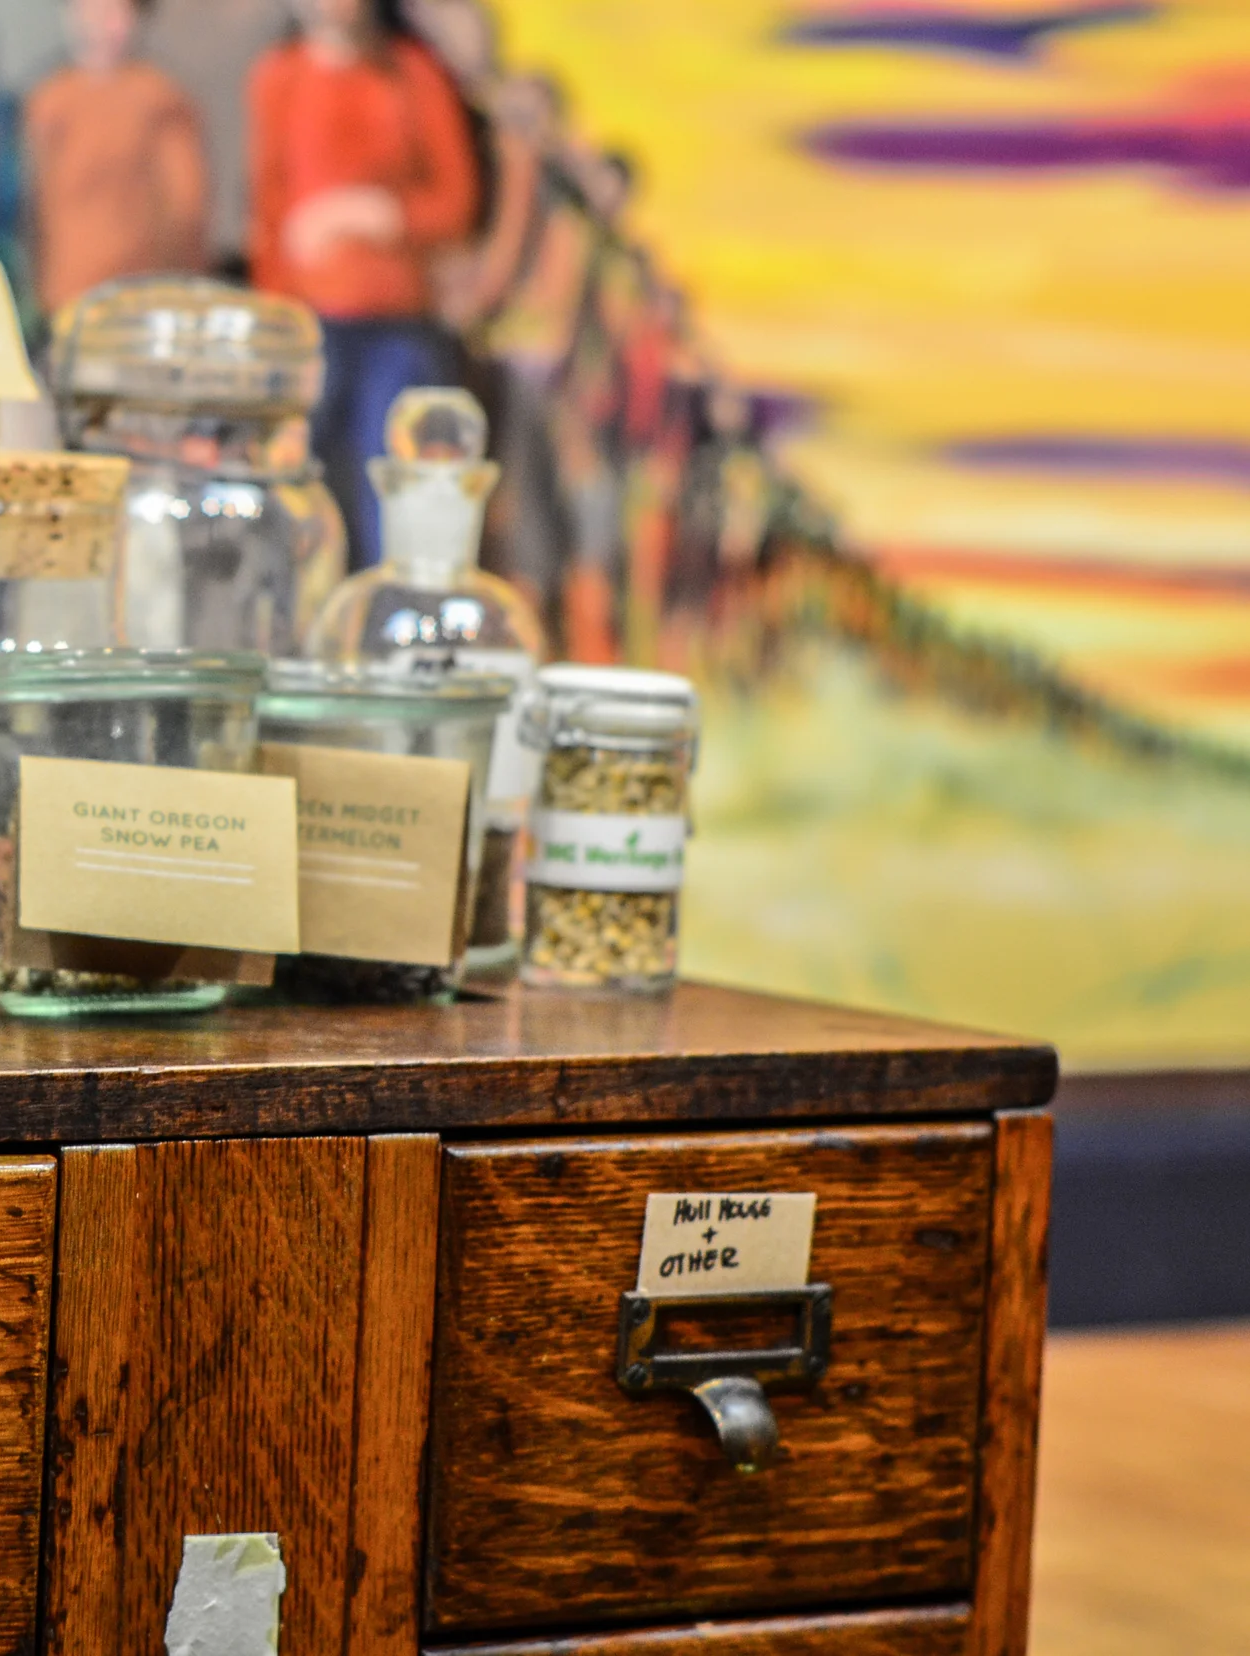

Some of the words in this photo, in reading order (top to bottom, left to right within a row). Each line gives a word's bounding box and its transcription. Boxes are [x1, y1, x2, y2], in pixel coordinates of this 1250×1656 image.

[73, 801, 141, 822] GIANT
[149, 810, 246, 831] OREGON
[341, 803, 422, 826] MIDGET
[101, 826, 172, 848] SNOW
[180, 834, 221, 853] PEA
[659, 1247, 739, 1278] OTHER
